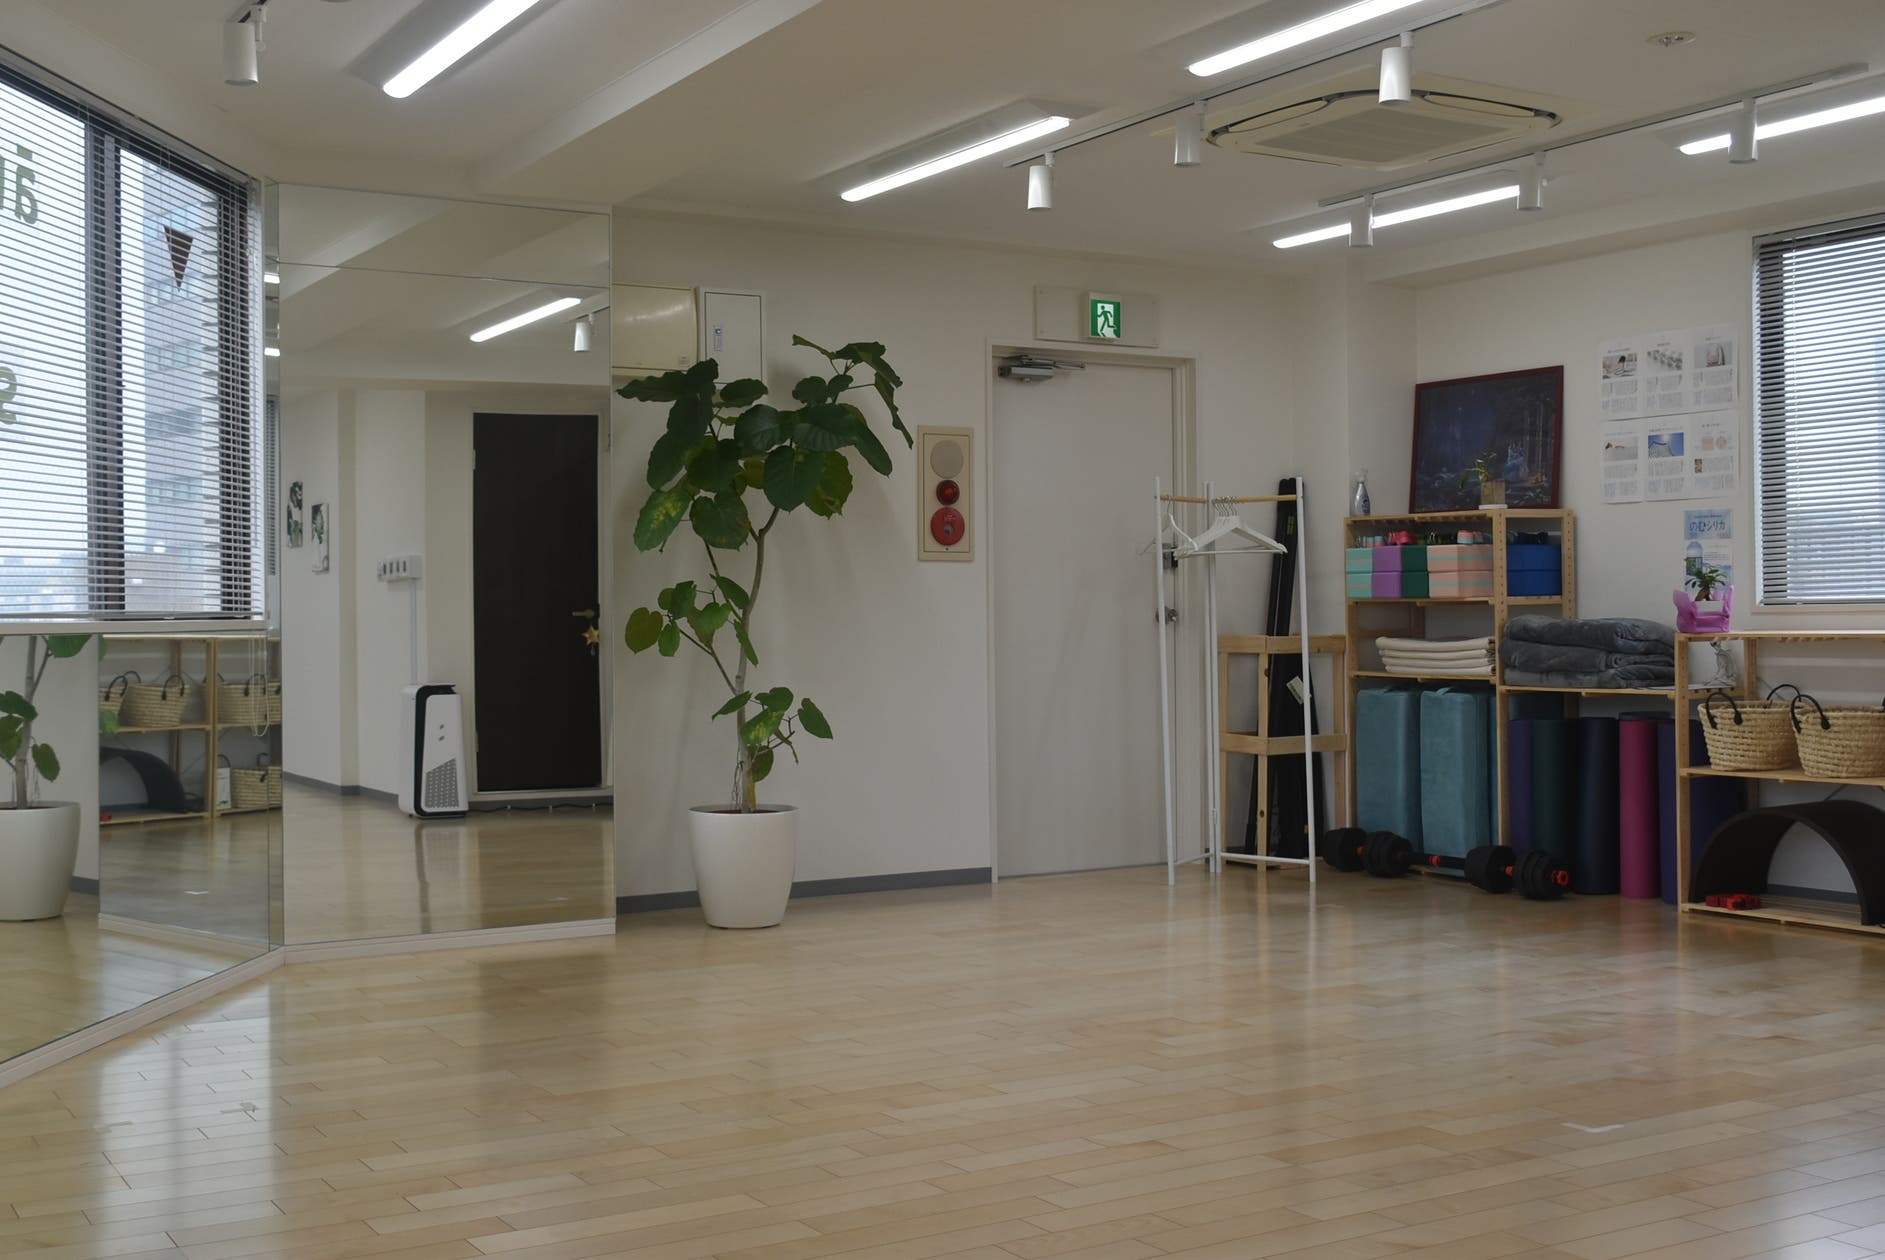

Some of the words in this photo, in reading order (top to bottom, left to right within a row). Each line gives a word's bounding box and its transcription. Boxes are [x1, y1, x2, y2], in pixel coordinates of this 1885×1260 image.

[1689, 519, 1726, 532] のむシリカ
